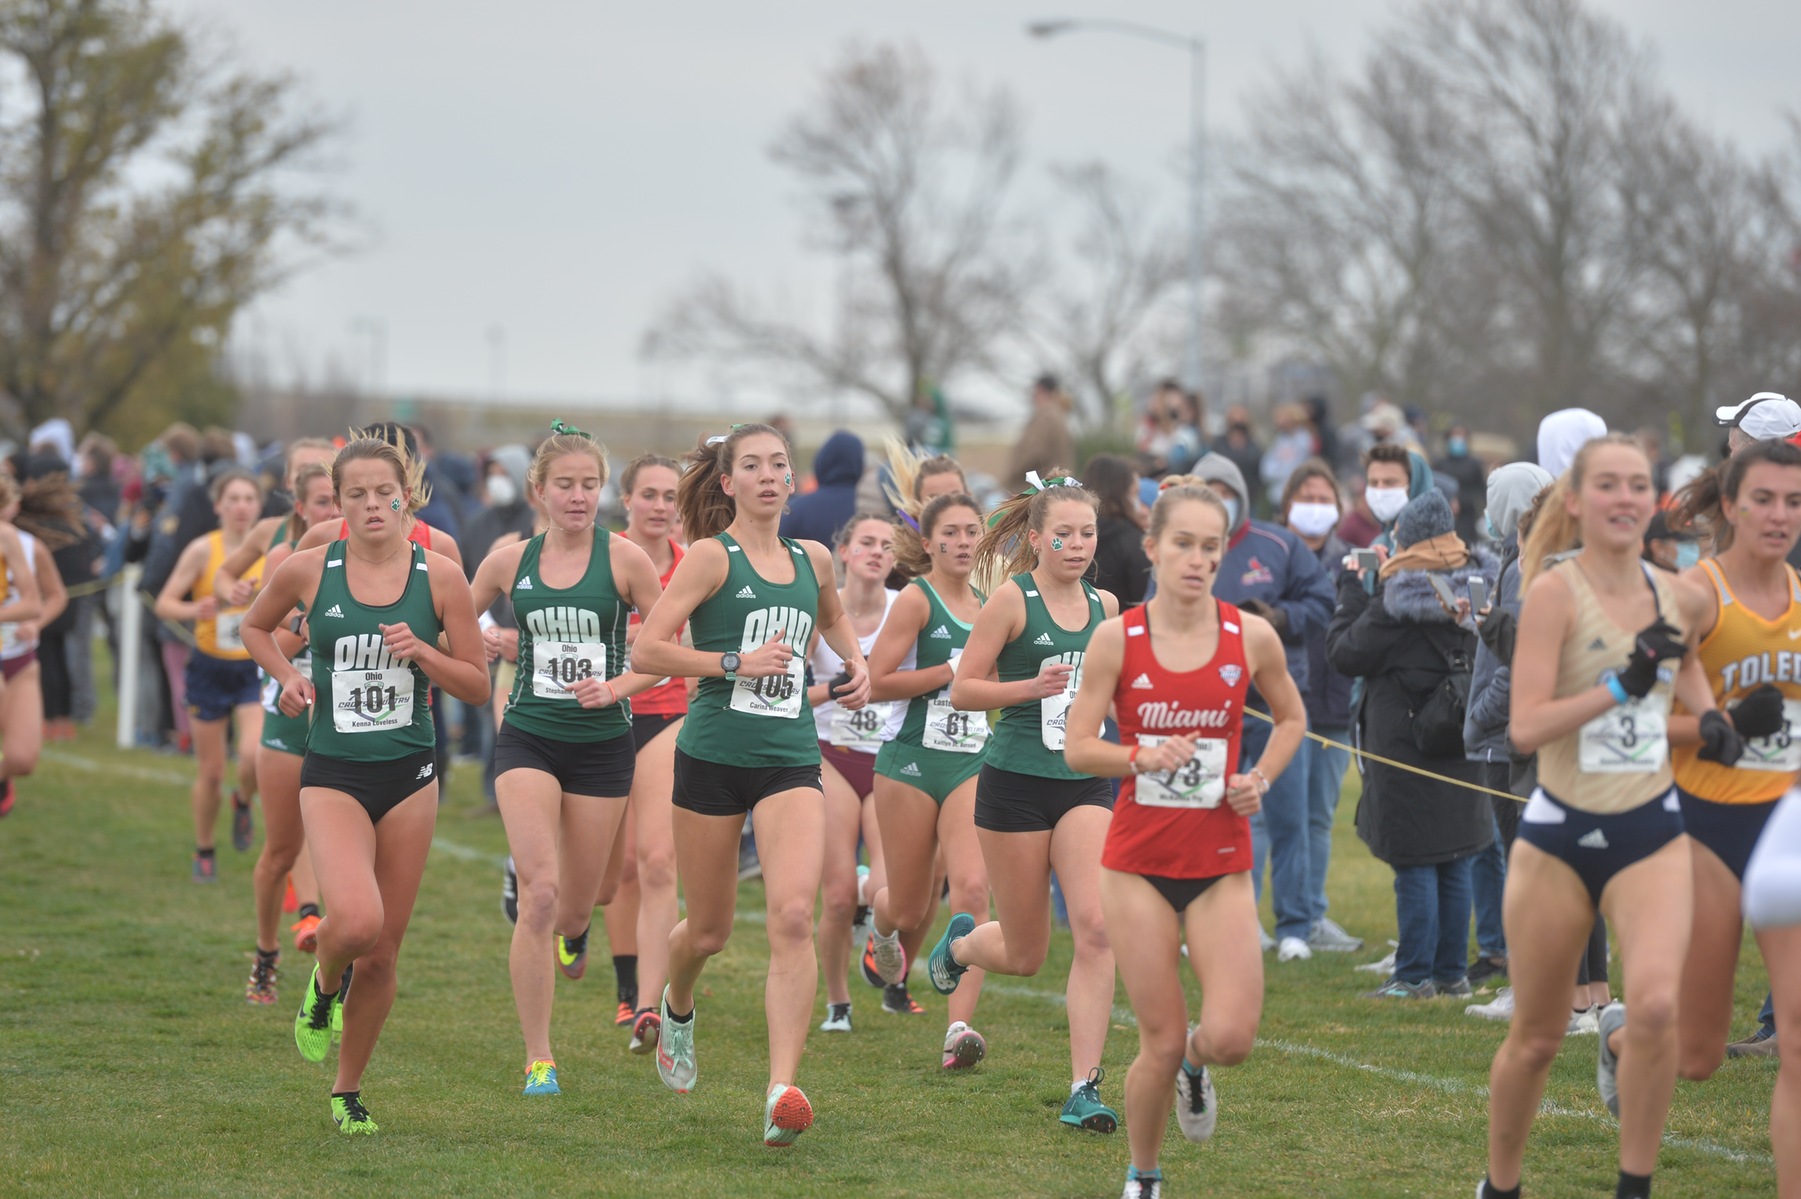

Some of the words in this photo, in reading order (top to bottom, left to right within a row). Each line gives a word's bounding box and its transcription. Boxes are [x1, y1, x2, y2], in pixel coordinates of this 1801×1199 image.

[526, 606, 600, 643] OHIO
[741, 606, 812, 657] OHIO
[334, 633, 411, 671] OHI
[562, 644, 577, 652] Ohio
[365, 672, 383, 681] Ohio
[548, 657, 592, 683] 103
[1720, 650, 1801, 692] TOLED
[755, 673, 795, 699] 105
[350, 686, 396, 713] 101
[372, 718, 398, 726] Loveless
[850, 710, 878, 731] 48
[947, 712, 969, 736] 61
[1137, 699, 1232, 729] Miami
[1620, 716, 1637, 749] 3
